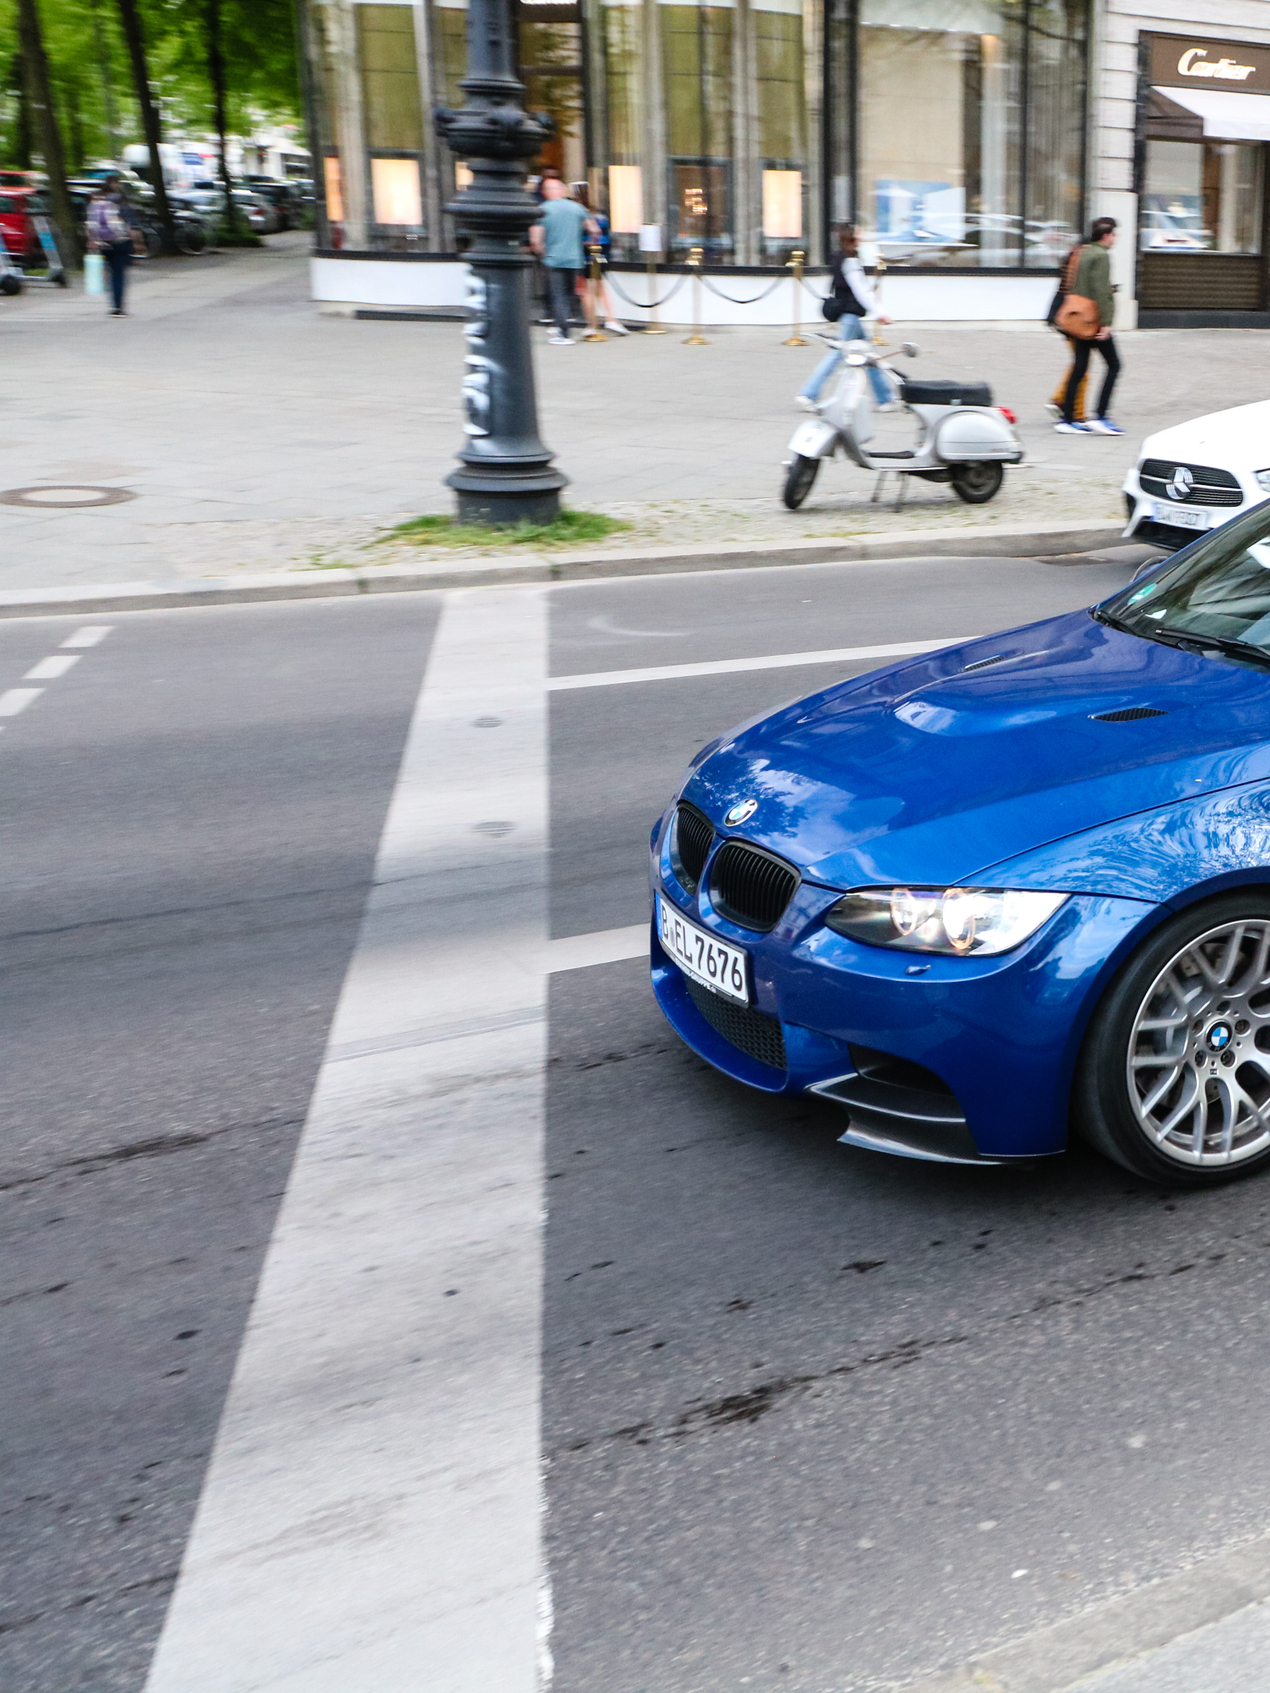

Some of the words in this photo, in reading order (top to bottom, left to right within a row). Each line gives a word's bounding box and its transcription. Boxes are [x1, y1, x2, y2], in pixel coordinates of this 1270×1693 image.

[1177, 47, 1256, 80] Cartier
[661, 904, 669, 940] B
[695, 934, 743, 992] 7676
